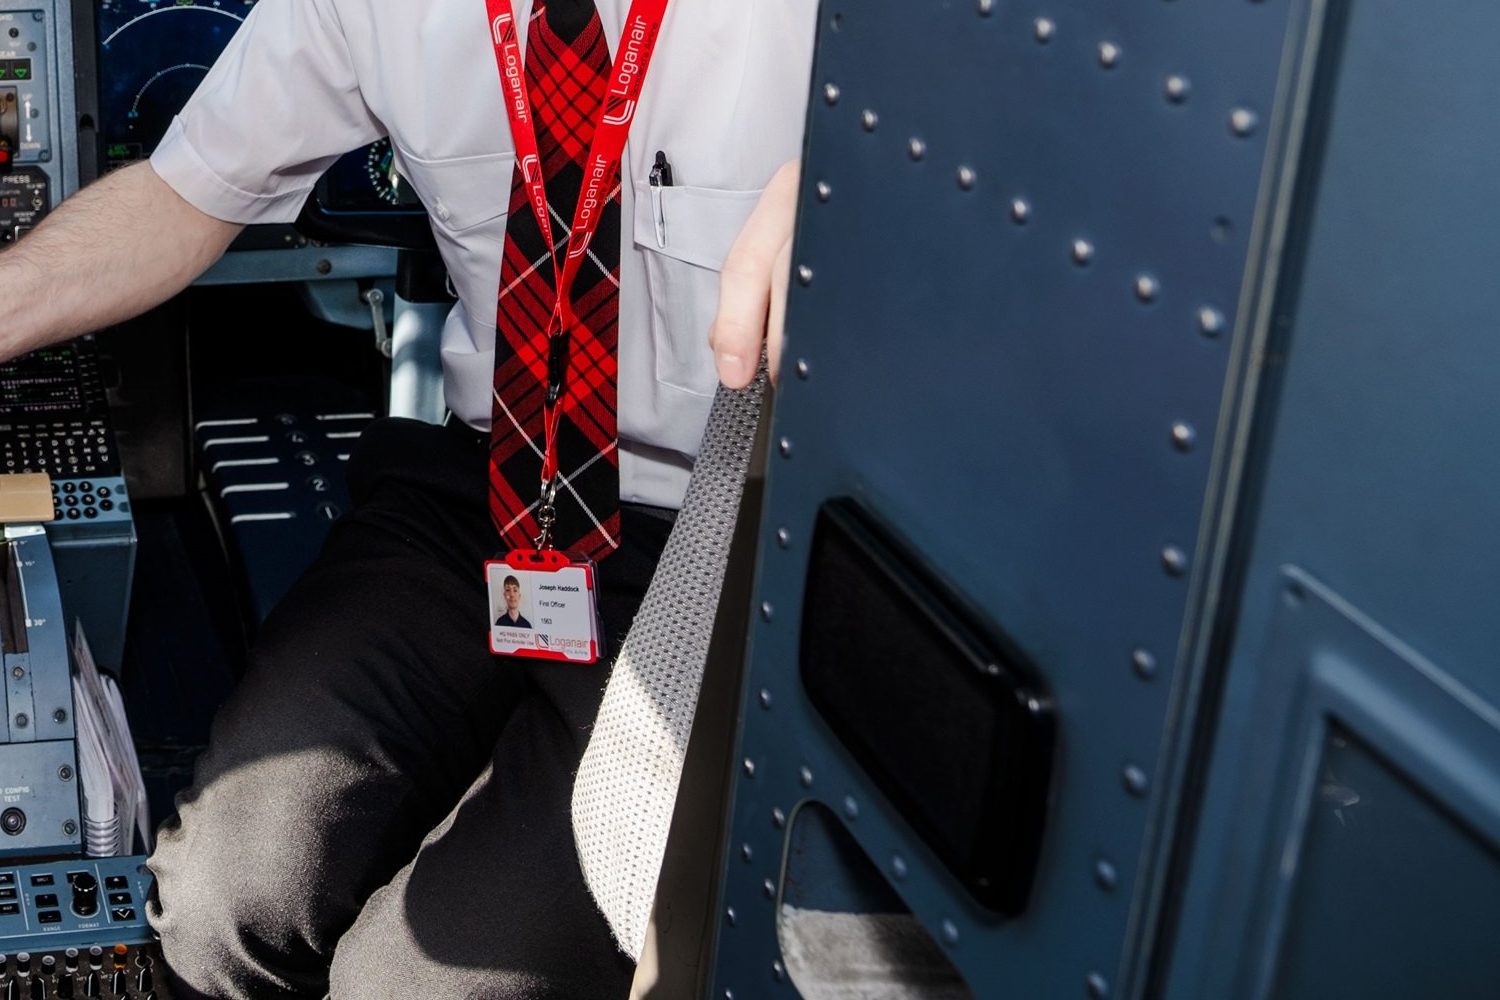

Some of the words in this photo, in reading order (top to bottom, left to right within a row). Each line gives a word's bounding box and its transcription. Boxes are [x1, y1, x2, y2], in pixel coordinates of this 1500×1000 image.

[504, 43, 528, 124] Loganair
[611, 14, 648, 96] Loganair
[575, 153, 605, 230] Loganair
[550, 634, 588, 648] Loganair
